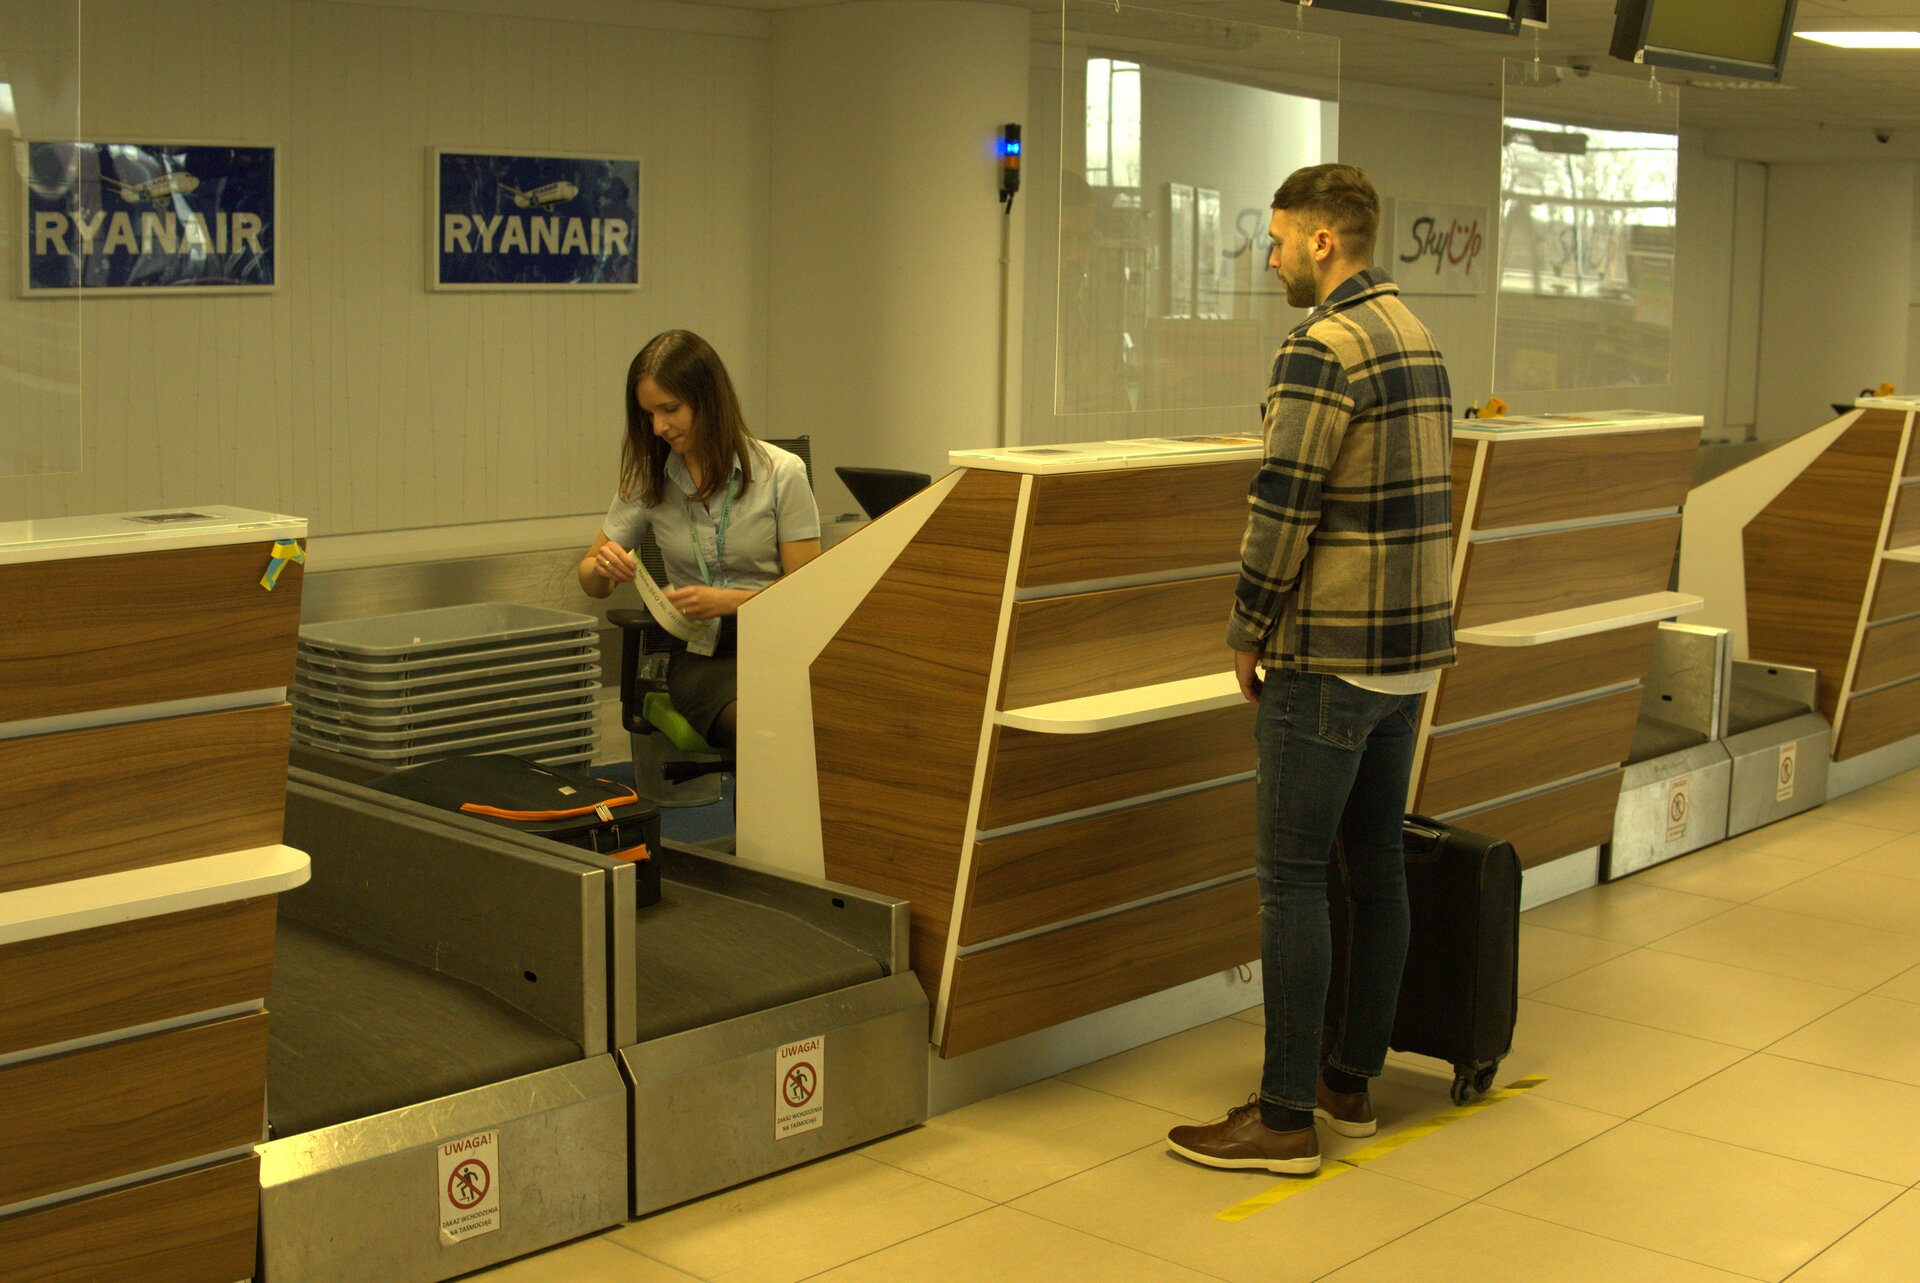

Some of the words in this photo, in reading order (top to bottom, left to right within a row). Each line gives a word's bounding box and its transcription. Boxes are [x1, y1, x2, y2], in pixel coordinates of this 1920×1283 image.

[34, 210, 265, 256] RYANAIR
[443, 212, 629, 256] RYANAIR
[781, 1039, 820, 1059] UWAGA!
[777, 1114, 793, 1125] ZAKAZ
[792, 1105, 823, 1120] WCHODZENIA
[782, 1124, 790, 1132] NA
[444, 1133, 492, 1156] UWAGA!
[442, 1218, 461, 1229] ZAKAZ
[460, 1206, 499, 1223] WCHODZENIA
